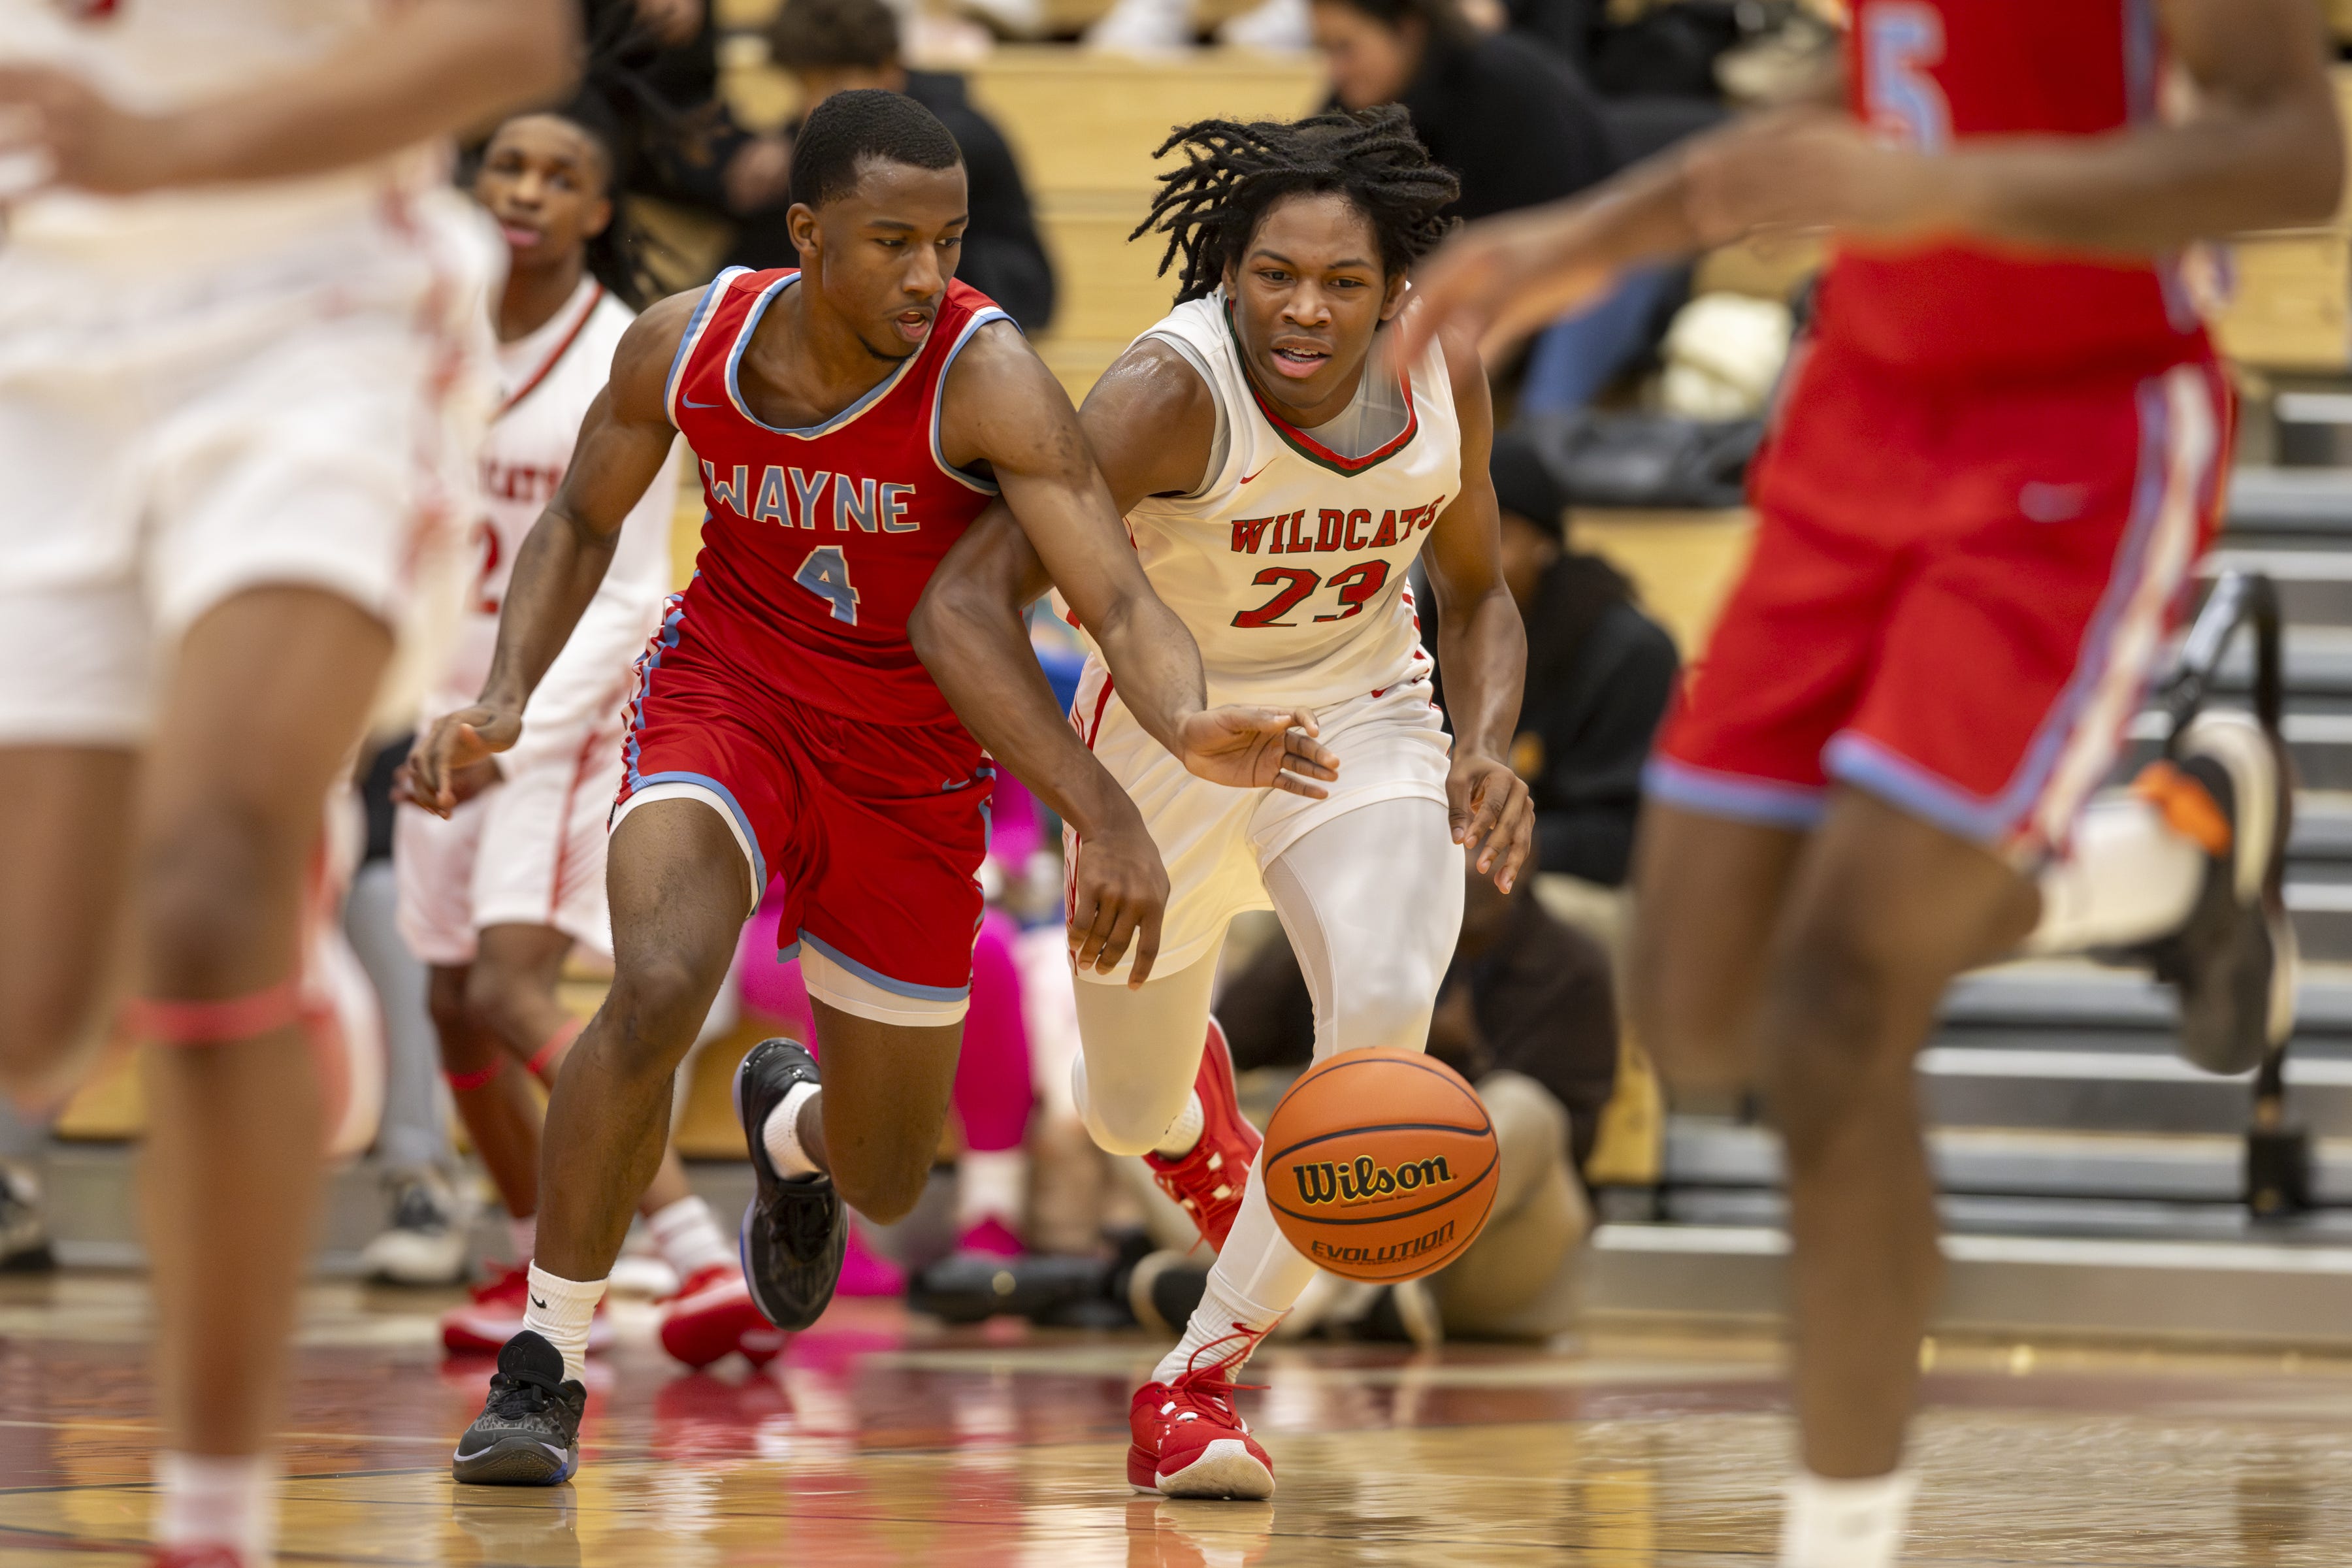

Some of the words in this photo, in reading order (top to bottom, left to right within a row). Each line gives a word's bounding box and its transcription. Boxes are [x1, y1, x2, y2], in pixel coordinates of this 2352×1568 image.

[1861, 1, 1953, 155] 5
[702, 458, 920, 533] WAYNE
[1231, 495, 1445, 554] WILDCATS
[792, 545, 860, 627] 4
[1230, 559, 1390, 628] 23
[1292, 1154, 1453, 1206] Wilson
[1311, 1220, 1454, 1262] EVOLUTION
